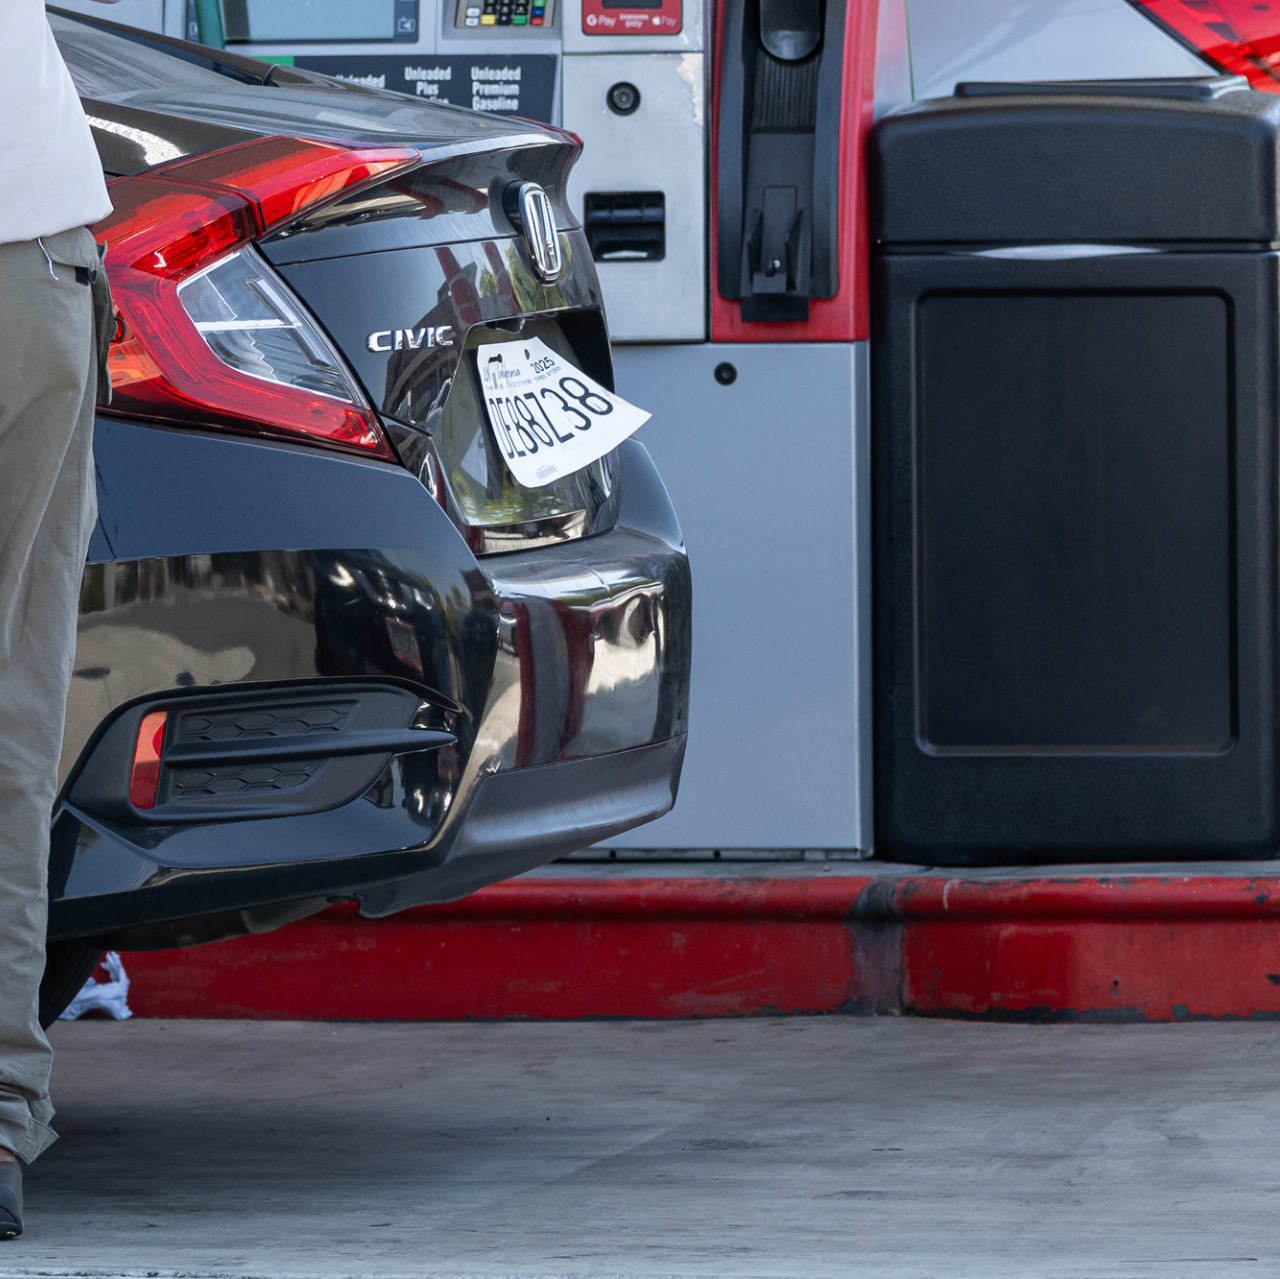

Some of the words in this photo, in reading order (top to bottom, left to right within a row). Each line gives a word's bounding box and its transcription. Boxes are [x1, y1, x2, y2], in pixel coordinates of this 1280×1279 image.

[599, 15, 616, 27] Pay
[662, 16, 677, 27] Pay
[404, 66, 451, 81] Unleaded
[471, 66, 521, 81] Unleaded
[416, 82, 439, 96] Plus
[473, 82, 519, 96] Premium
[473, 97, 519, 111] Gasoline
[366, 324, 457, 353] CIVIC
[530, 356, 556, 374] 2025
[489, 377, 614, 460] DE88Z38
